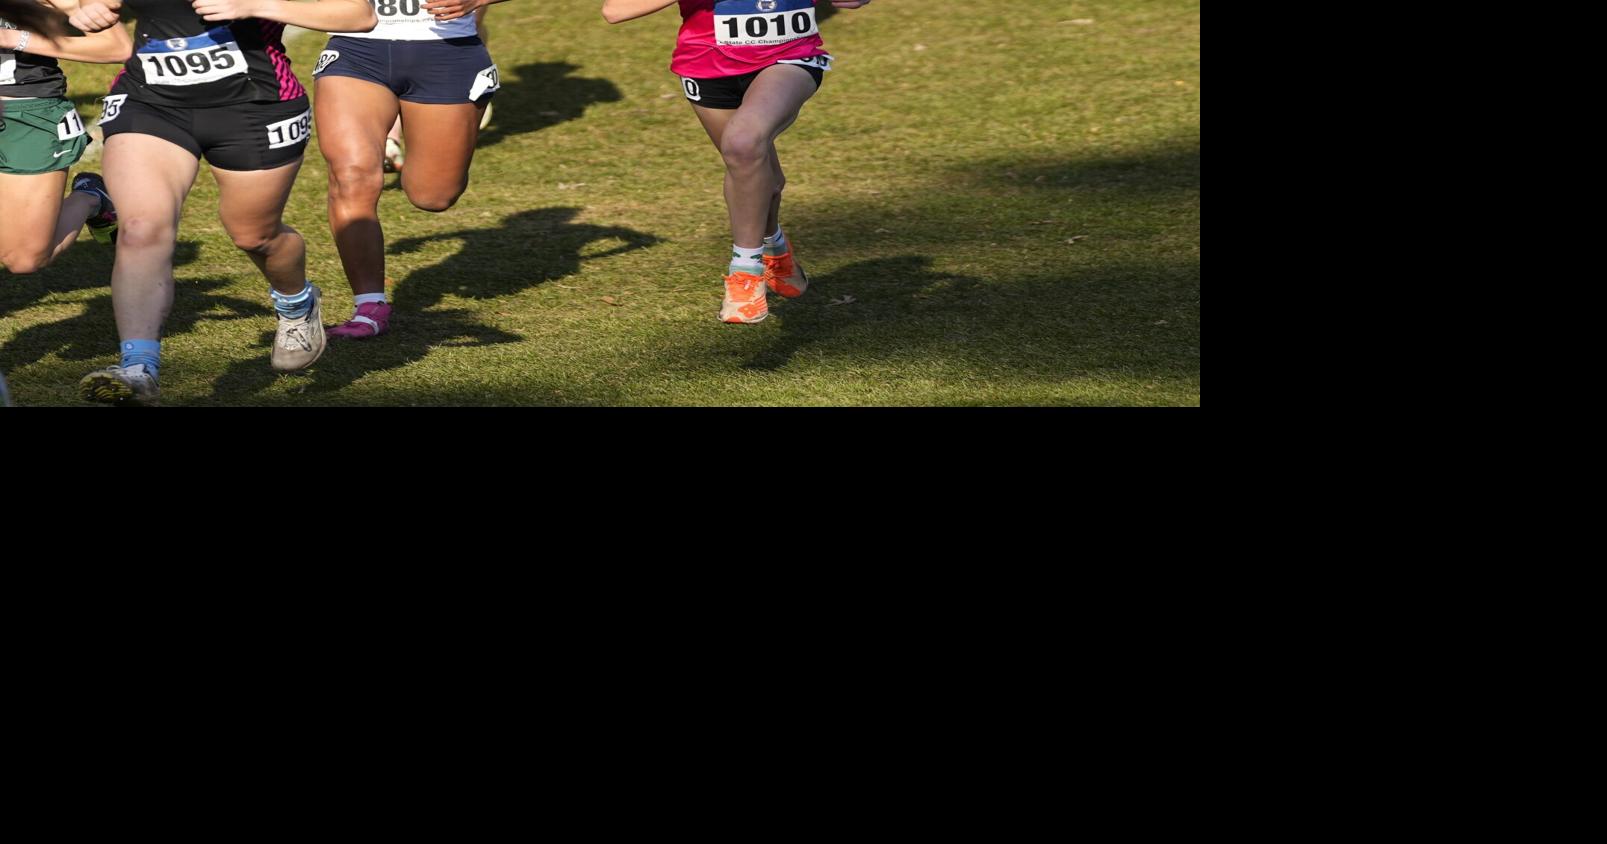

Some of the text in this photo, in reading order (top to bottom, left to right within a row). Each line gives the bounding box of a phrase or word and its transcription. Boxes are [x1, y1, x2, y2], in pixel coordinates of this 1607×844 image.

[369, 0, 420, 16] 80
[722, 12, 811, 38] 1010
[147, 46, 235, 76] 1095
